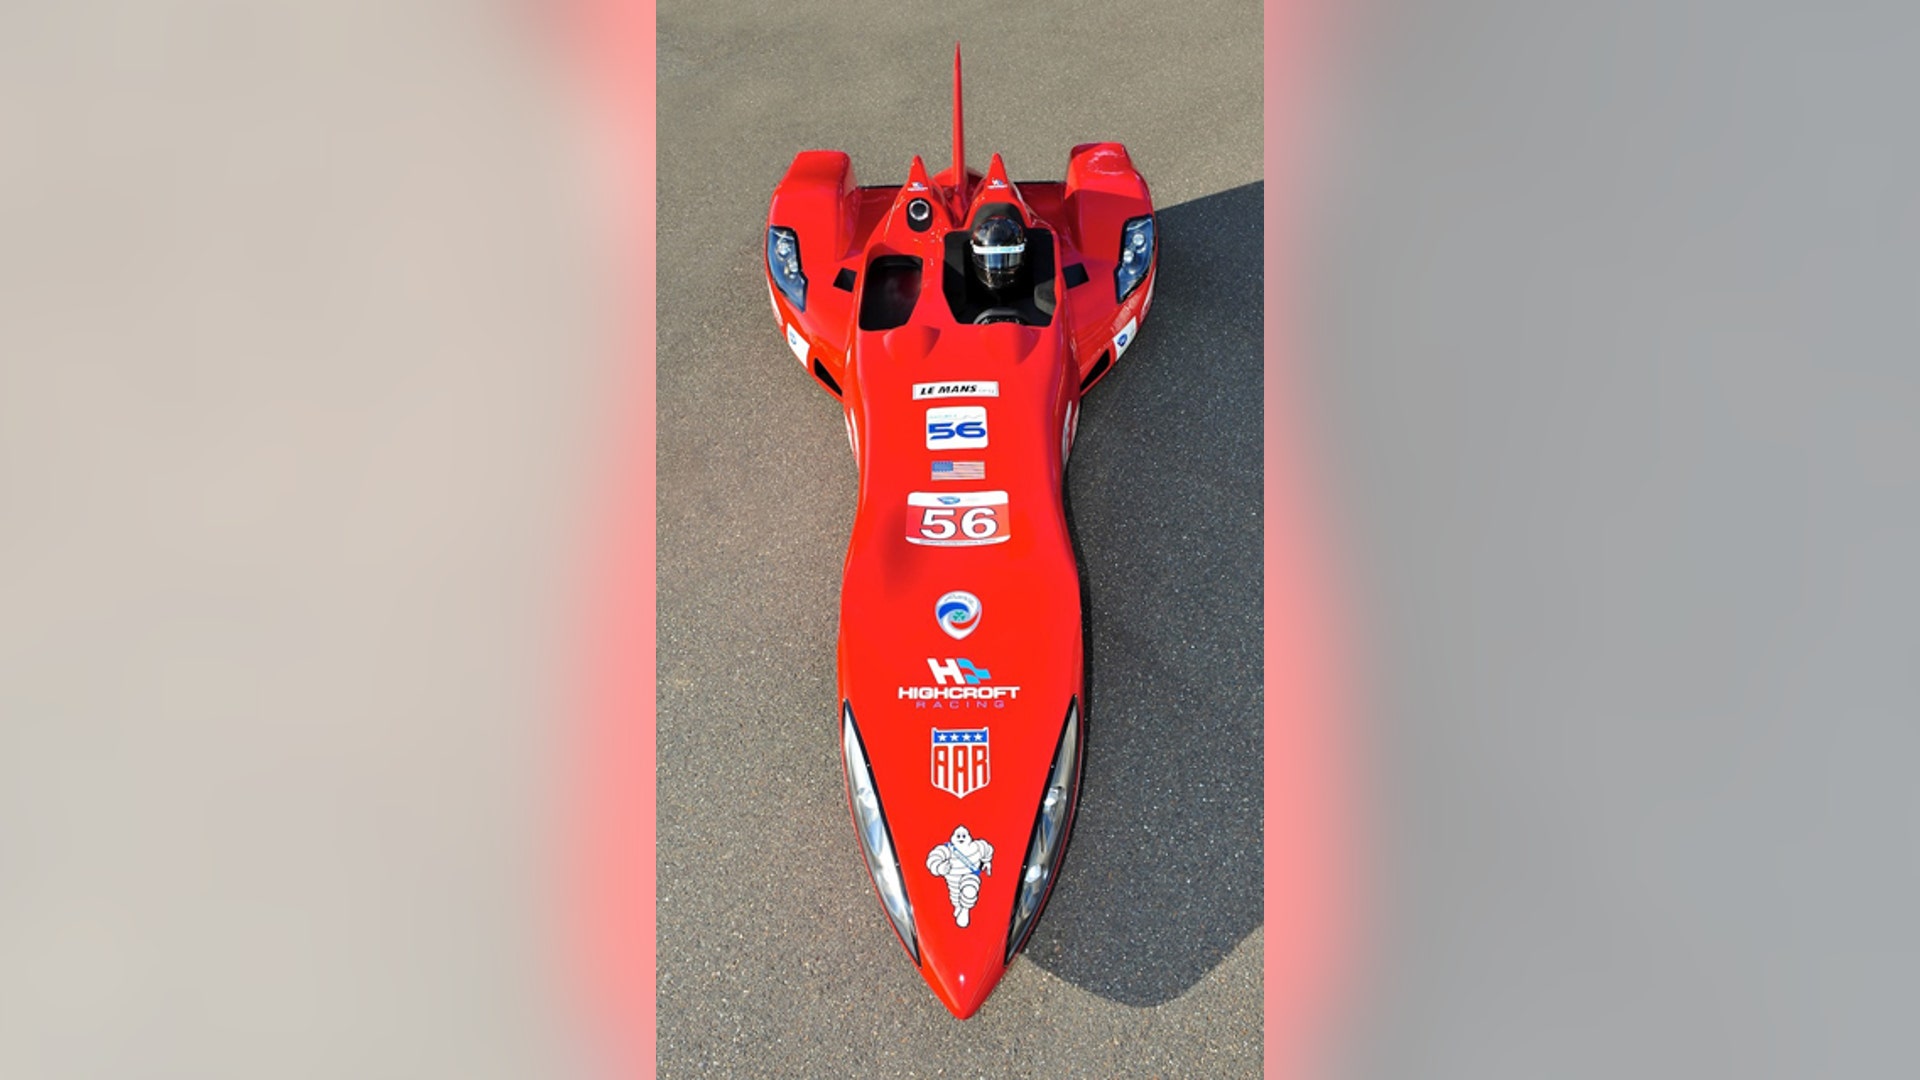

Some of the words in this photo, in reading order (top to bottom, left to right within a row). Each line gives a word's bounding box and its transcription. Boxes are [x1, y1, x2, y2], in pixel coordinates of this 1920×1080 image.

[920, 386, 935, 395] LE
[938, 384, 978, 394] MANS
[928, 421, 986, 440] 56
[919, 507, 999, 540] 56
[898, 686, 1020, 699] HIGHCROFT
[915, 700, 1005, 709] RACING
[933, 745, 988, 794] AAR
